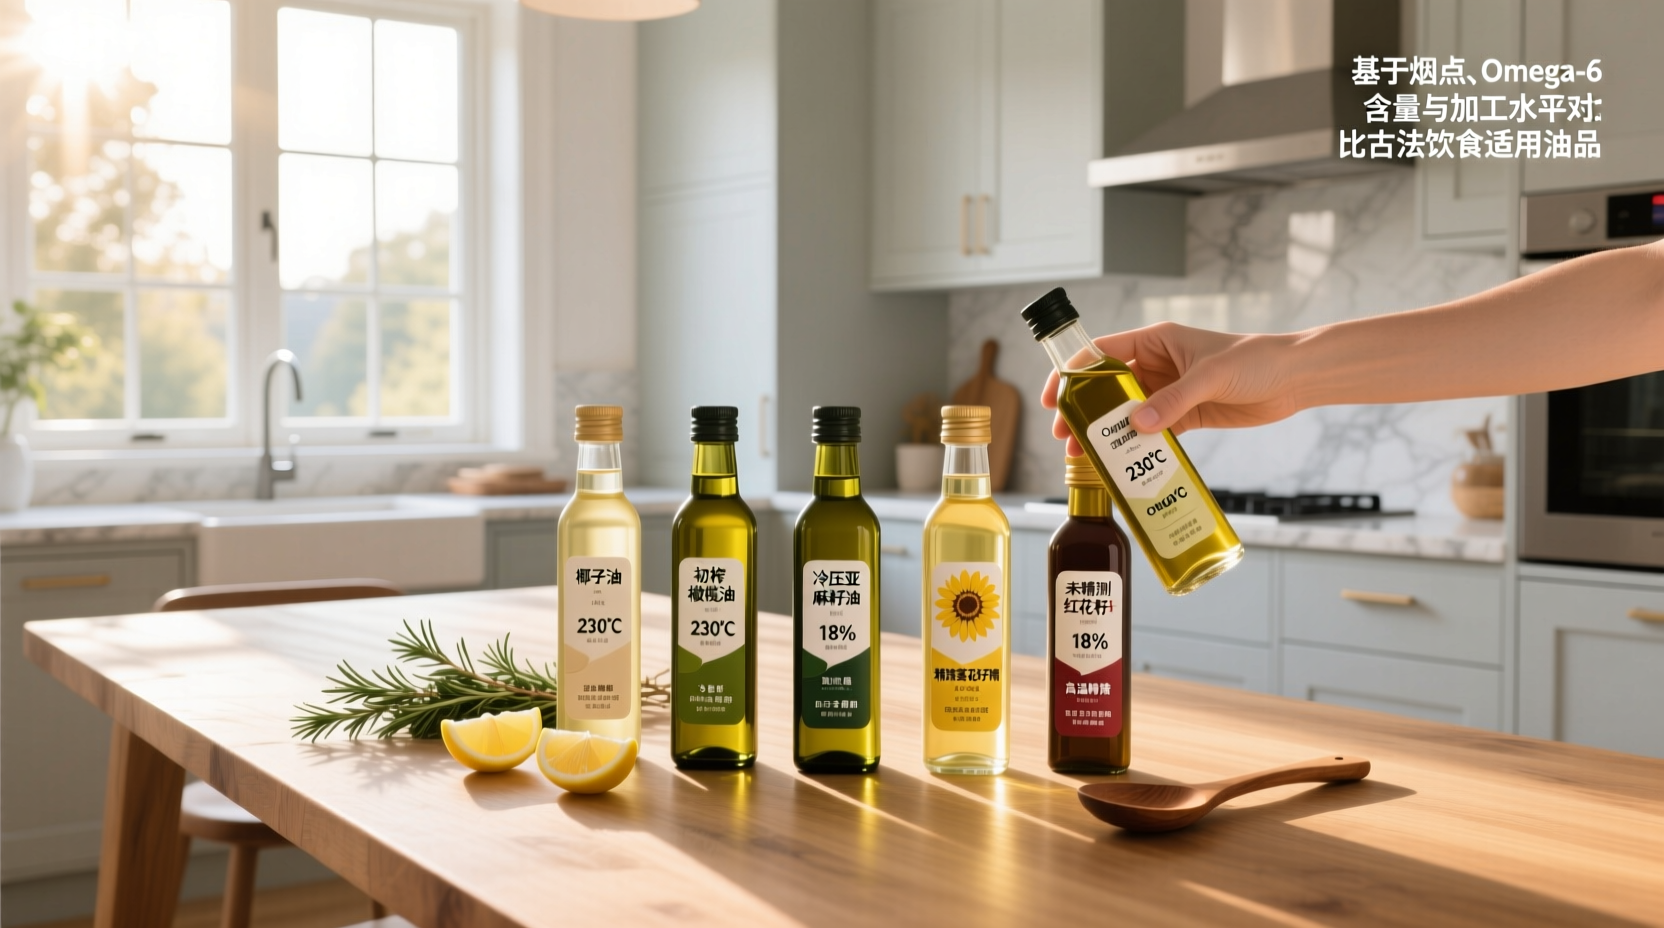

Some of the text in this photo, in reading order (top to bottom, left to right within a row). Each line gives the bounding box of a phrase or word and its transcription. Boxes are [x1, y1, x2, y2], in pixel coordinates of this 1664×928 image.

[576, 568, 622, 586] 椰子油
[819, 624, 857, 641] 18%
[1072, 632, 1109, 650] 18%
